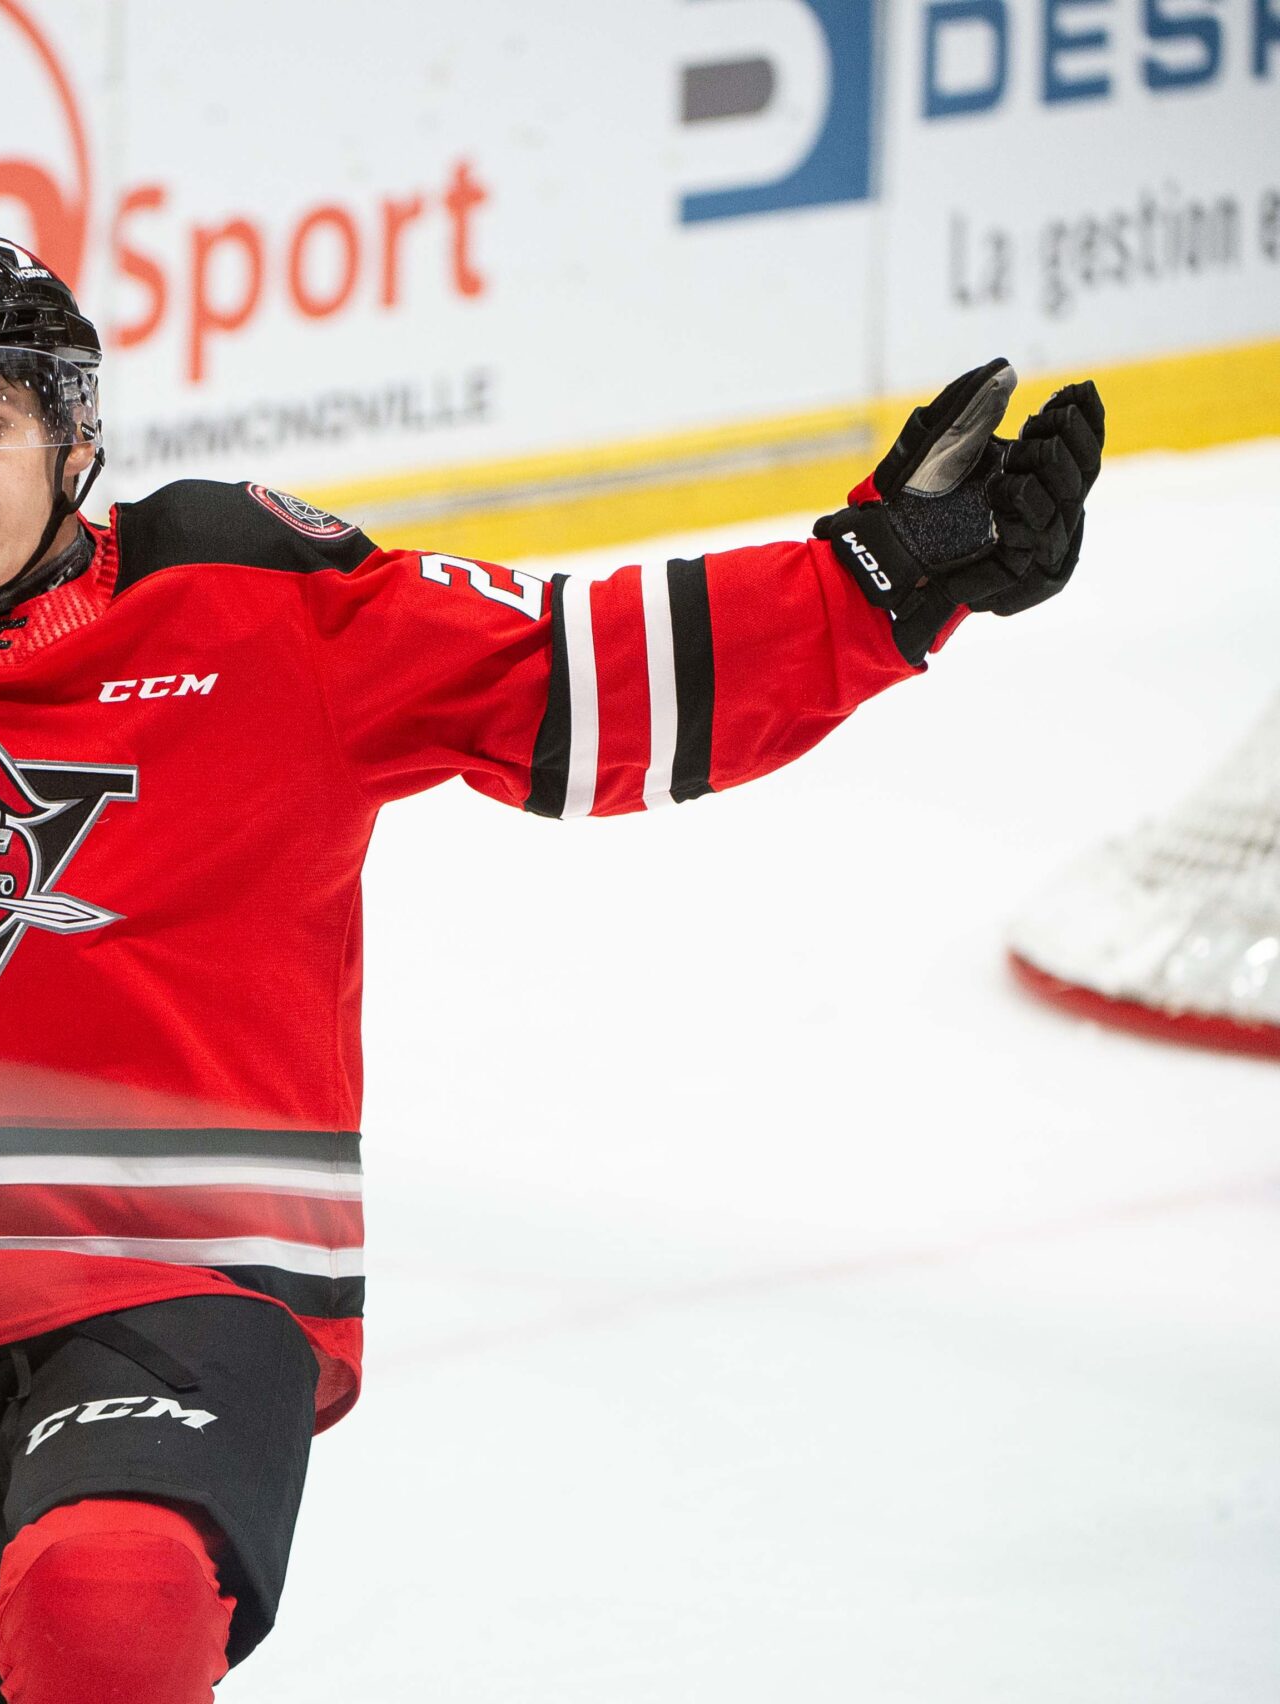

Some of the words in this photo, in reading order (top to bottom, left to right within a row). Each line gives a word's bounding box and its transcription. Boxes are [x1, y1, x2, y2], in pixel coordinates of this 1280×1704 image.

[920, 0, 1280, 121] DES
[948, 207, 1013, 308] La
[1040, 178, 1241, 322] gestion
[841, 531, 892, 591] CCM
[98, 673, 219, 703] CCM
[25, 1396, 219, 1456] CCM
